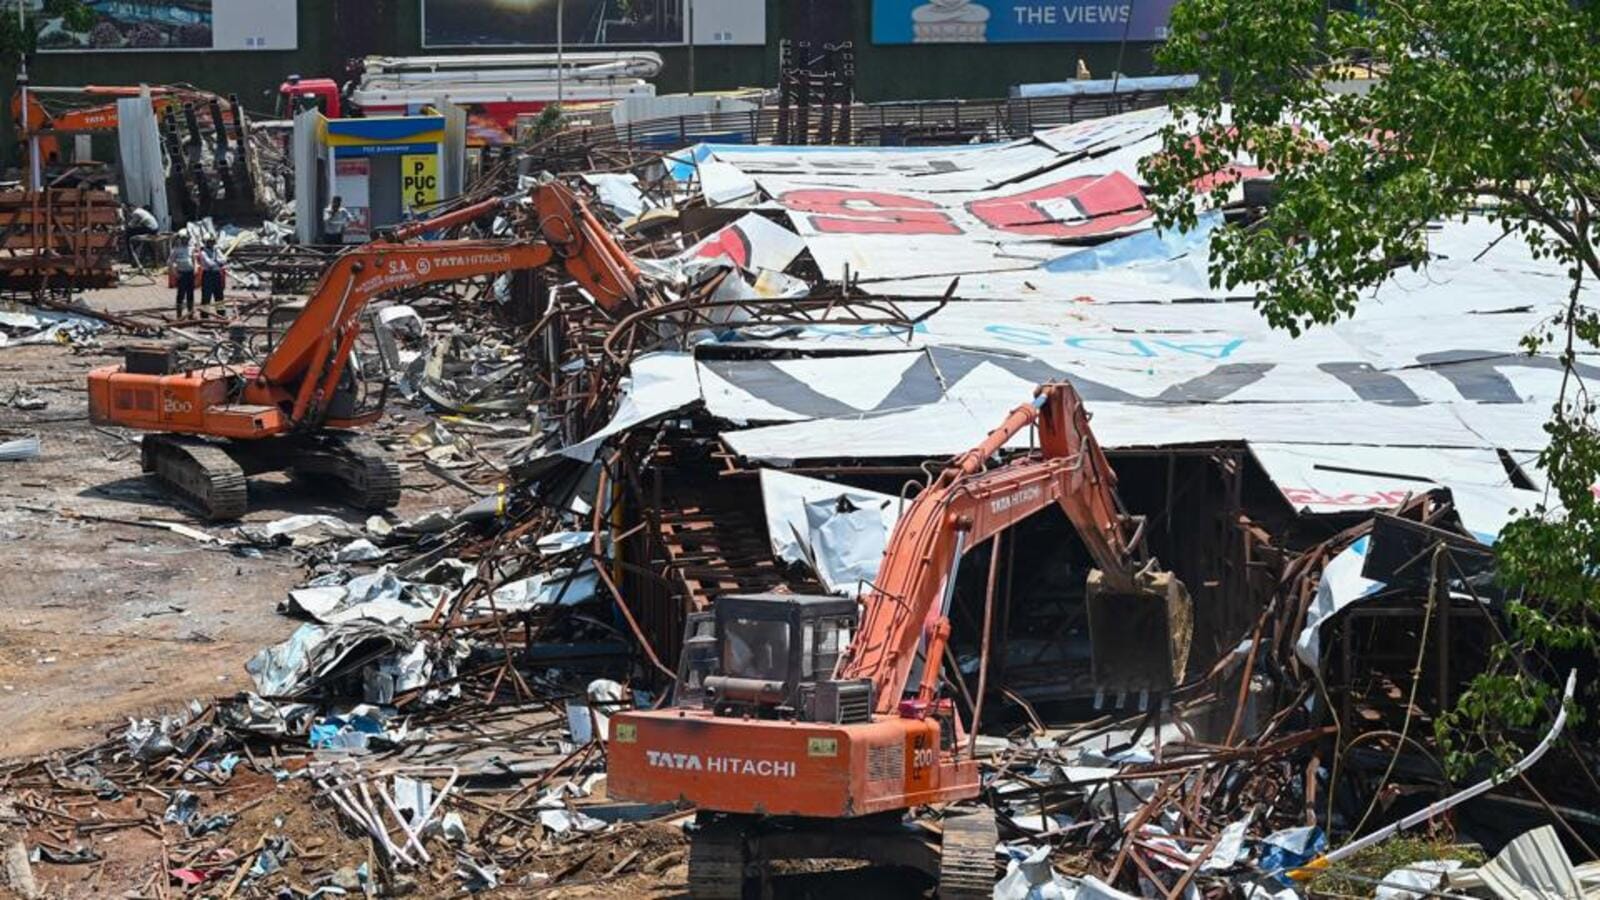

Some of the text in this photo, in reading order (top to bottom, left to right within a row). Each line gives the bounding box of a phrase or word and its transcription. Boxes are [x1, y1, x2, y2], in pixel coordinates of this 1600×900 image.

[1014, 5, 1131, 24] THE VIEWS
[84, 115, 106, 124] TATA
[404, 176, 436, 190] PUC
[433, 253, 511, 267] TATA HITACHI
[163, 399, 193, 414] 200
[991, 486, 1040, 514] TATA HITACHI
[646, 750, 796, 778] TATA HITACHI
[913, 748, 933, 768] 200
